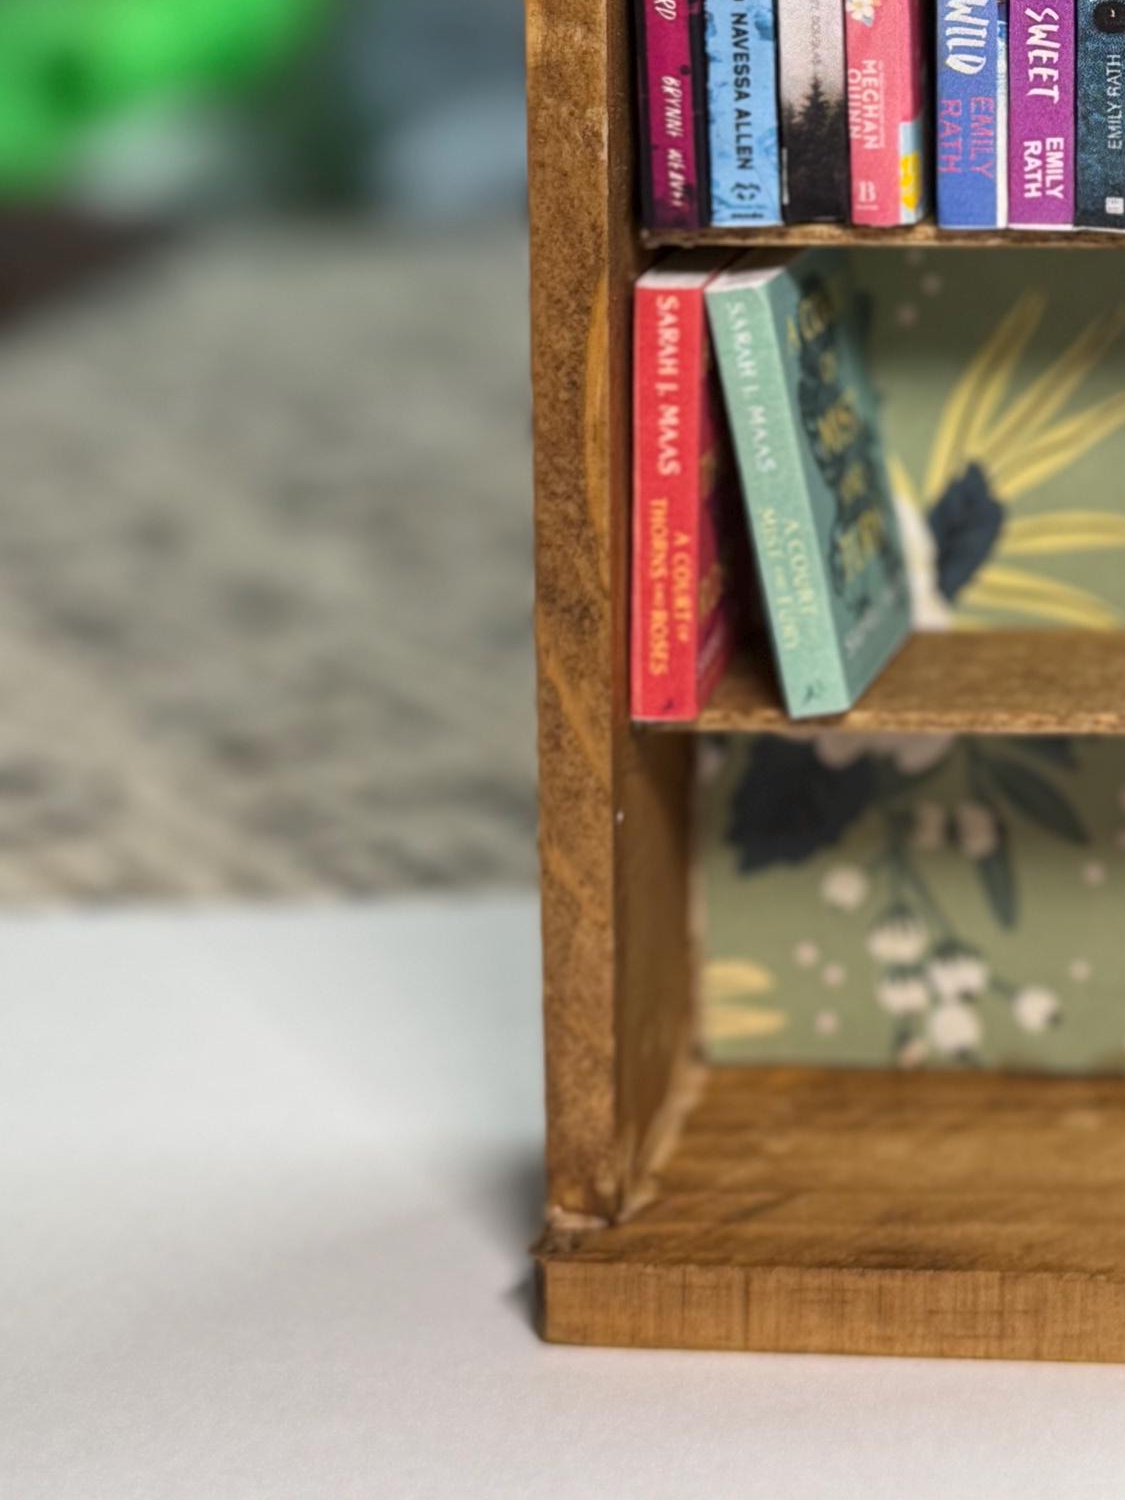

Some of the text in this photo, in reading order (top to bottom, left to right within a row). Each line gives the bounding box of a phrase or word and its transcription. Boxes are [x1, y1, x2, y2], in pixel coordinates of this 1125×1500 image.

[730, 12, 755, 170] NAVESSA ALLEN
[1024, 7, 1060, 104] SWEET
[861, 59, 883, 150] MEGHAN
[937, 99, 962, 175] RATH
[969, 94, 994, 179] EMILY
[1106, 53, 1123, 150] EMILY RATH
[1023, 140, 1043, 199] RATH
[1045, 136, 1064, 199] EMILY
[655, 295, 681, 375] SARAH
[724, 301, 759, 375] SARAH
[746, 405, 778, 473] MAAS
[656, 404, 681, 477] MAAS
[647, 497, 669, 580] THORNS
[673, 531, 691, 547] A
[783, 519, 802, 536] A
[672, 551, 692, 620] COURT
[785, 538, 817, 617] COURT
[648, 610, 670, 676] ROSES
